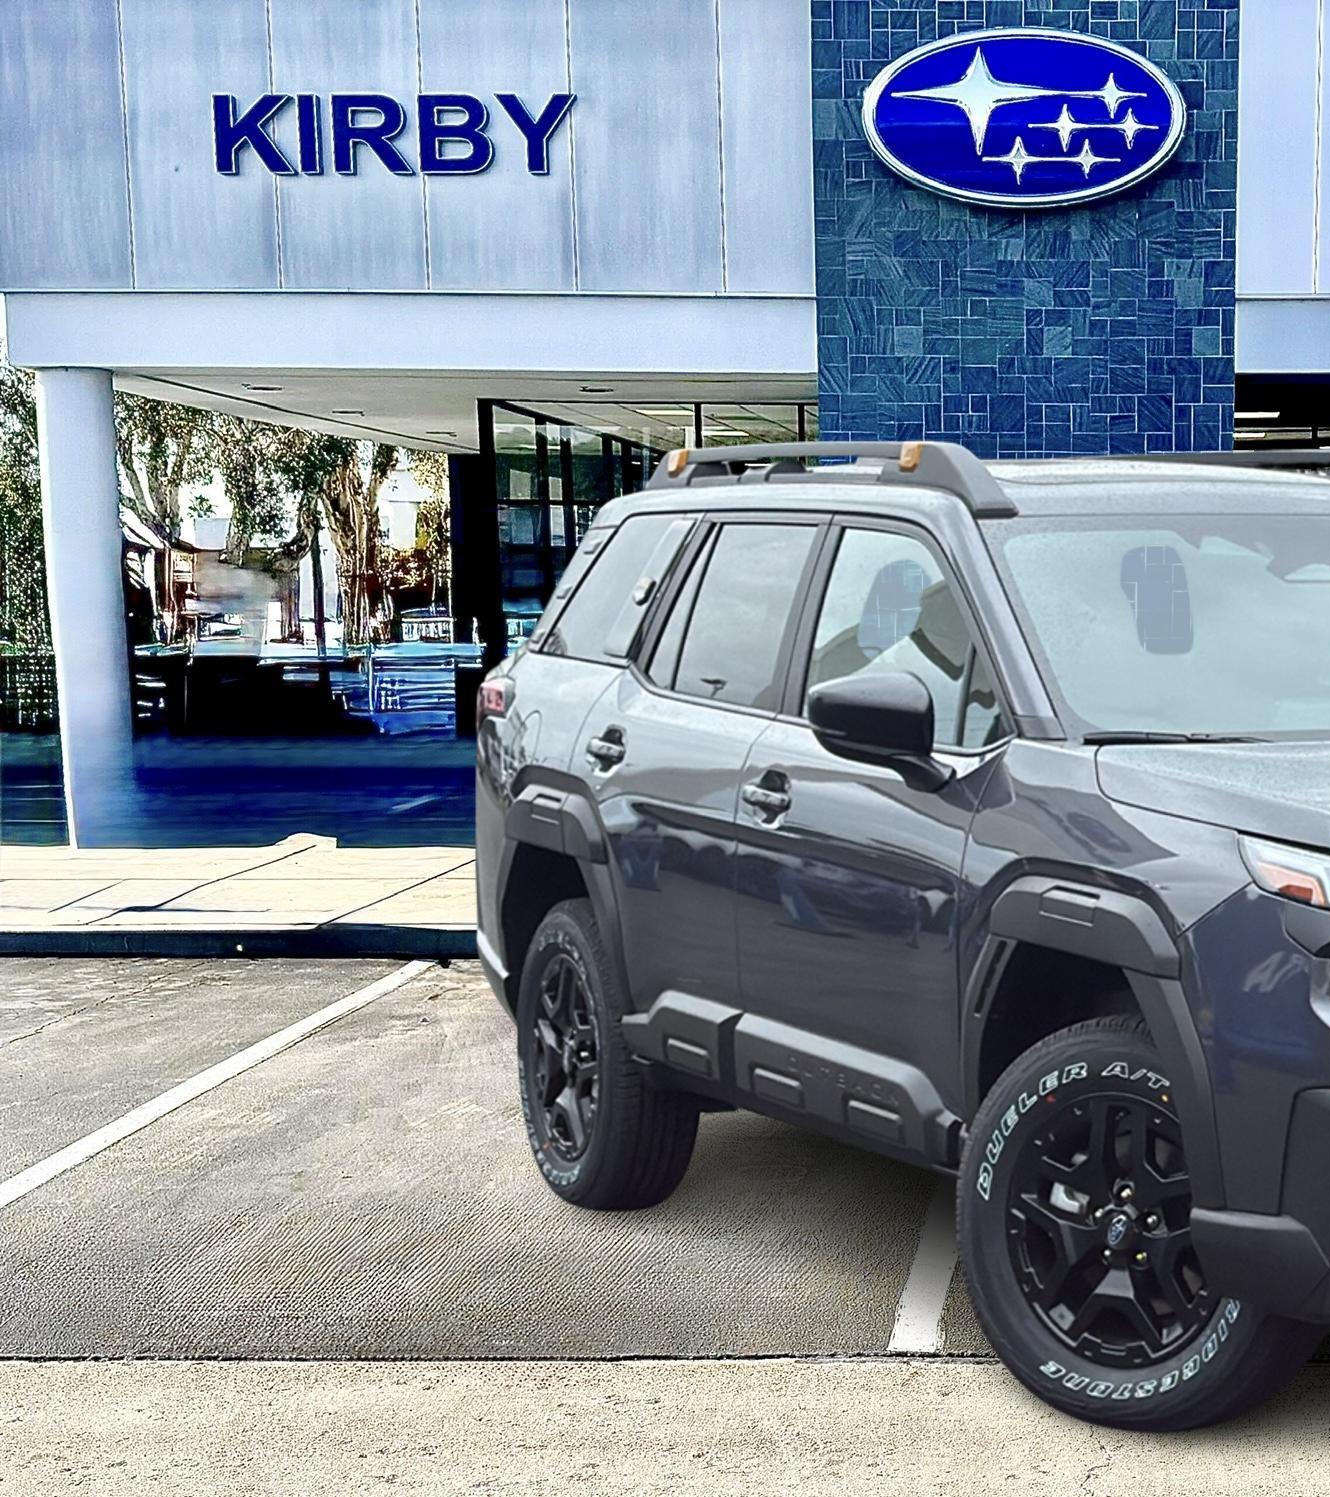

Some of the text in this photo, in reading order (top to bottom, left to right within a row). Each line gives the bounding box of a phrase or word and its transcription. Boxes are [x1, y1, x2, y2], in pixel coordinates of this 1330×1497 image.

[212, 92, 577, 176] KIRBY
[977, 1062, 1088, 1201] DUELER
[1101, 1061, 1170, 1089] A/T
[1039, 1299, 1240, 1400] RIDGESTONE
